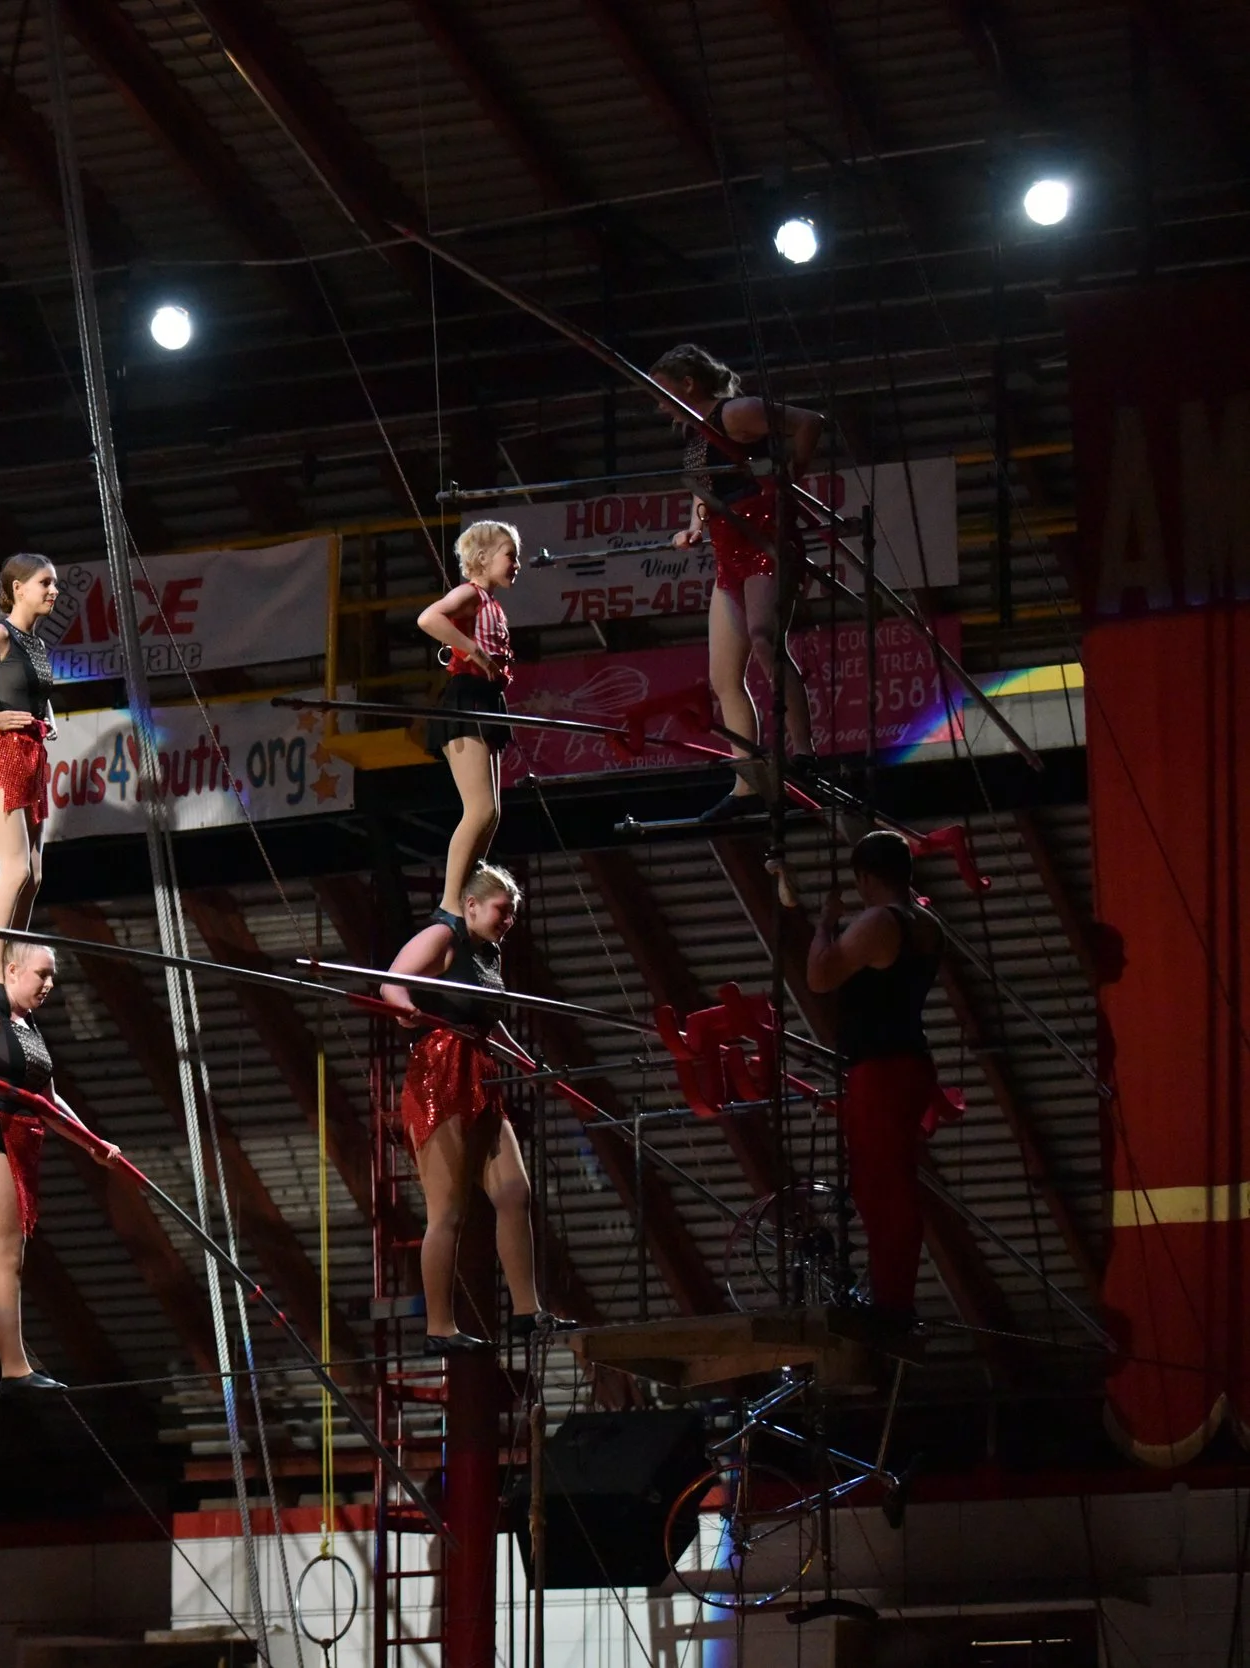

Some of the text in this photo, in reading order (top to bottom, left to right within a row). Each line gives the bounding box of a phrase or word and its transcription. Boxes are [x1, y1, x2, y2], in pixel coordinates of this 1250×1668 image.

[640, 557, 689, 580] Vinyl
[60, 576, 203, 645] ACE
[821, 656, 868, 680] SWEE
